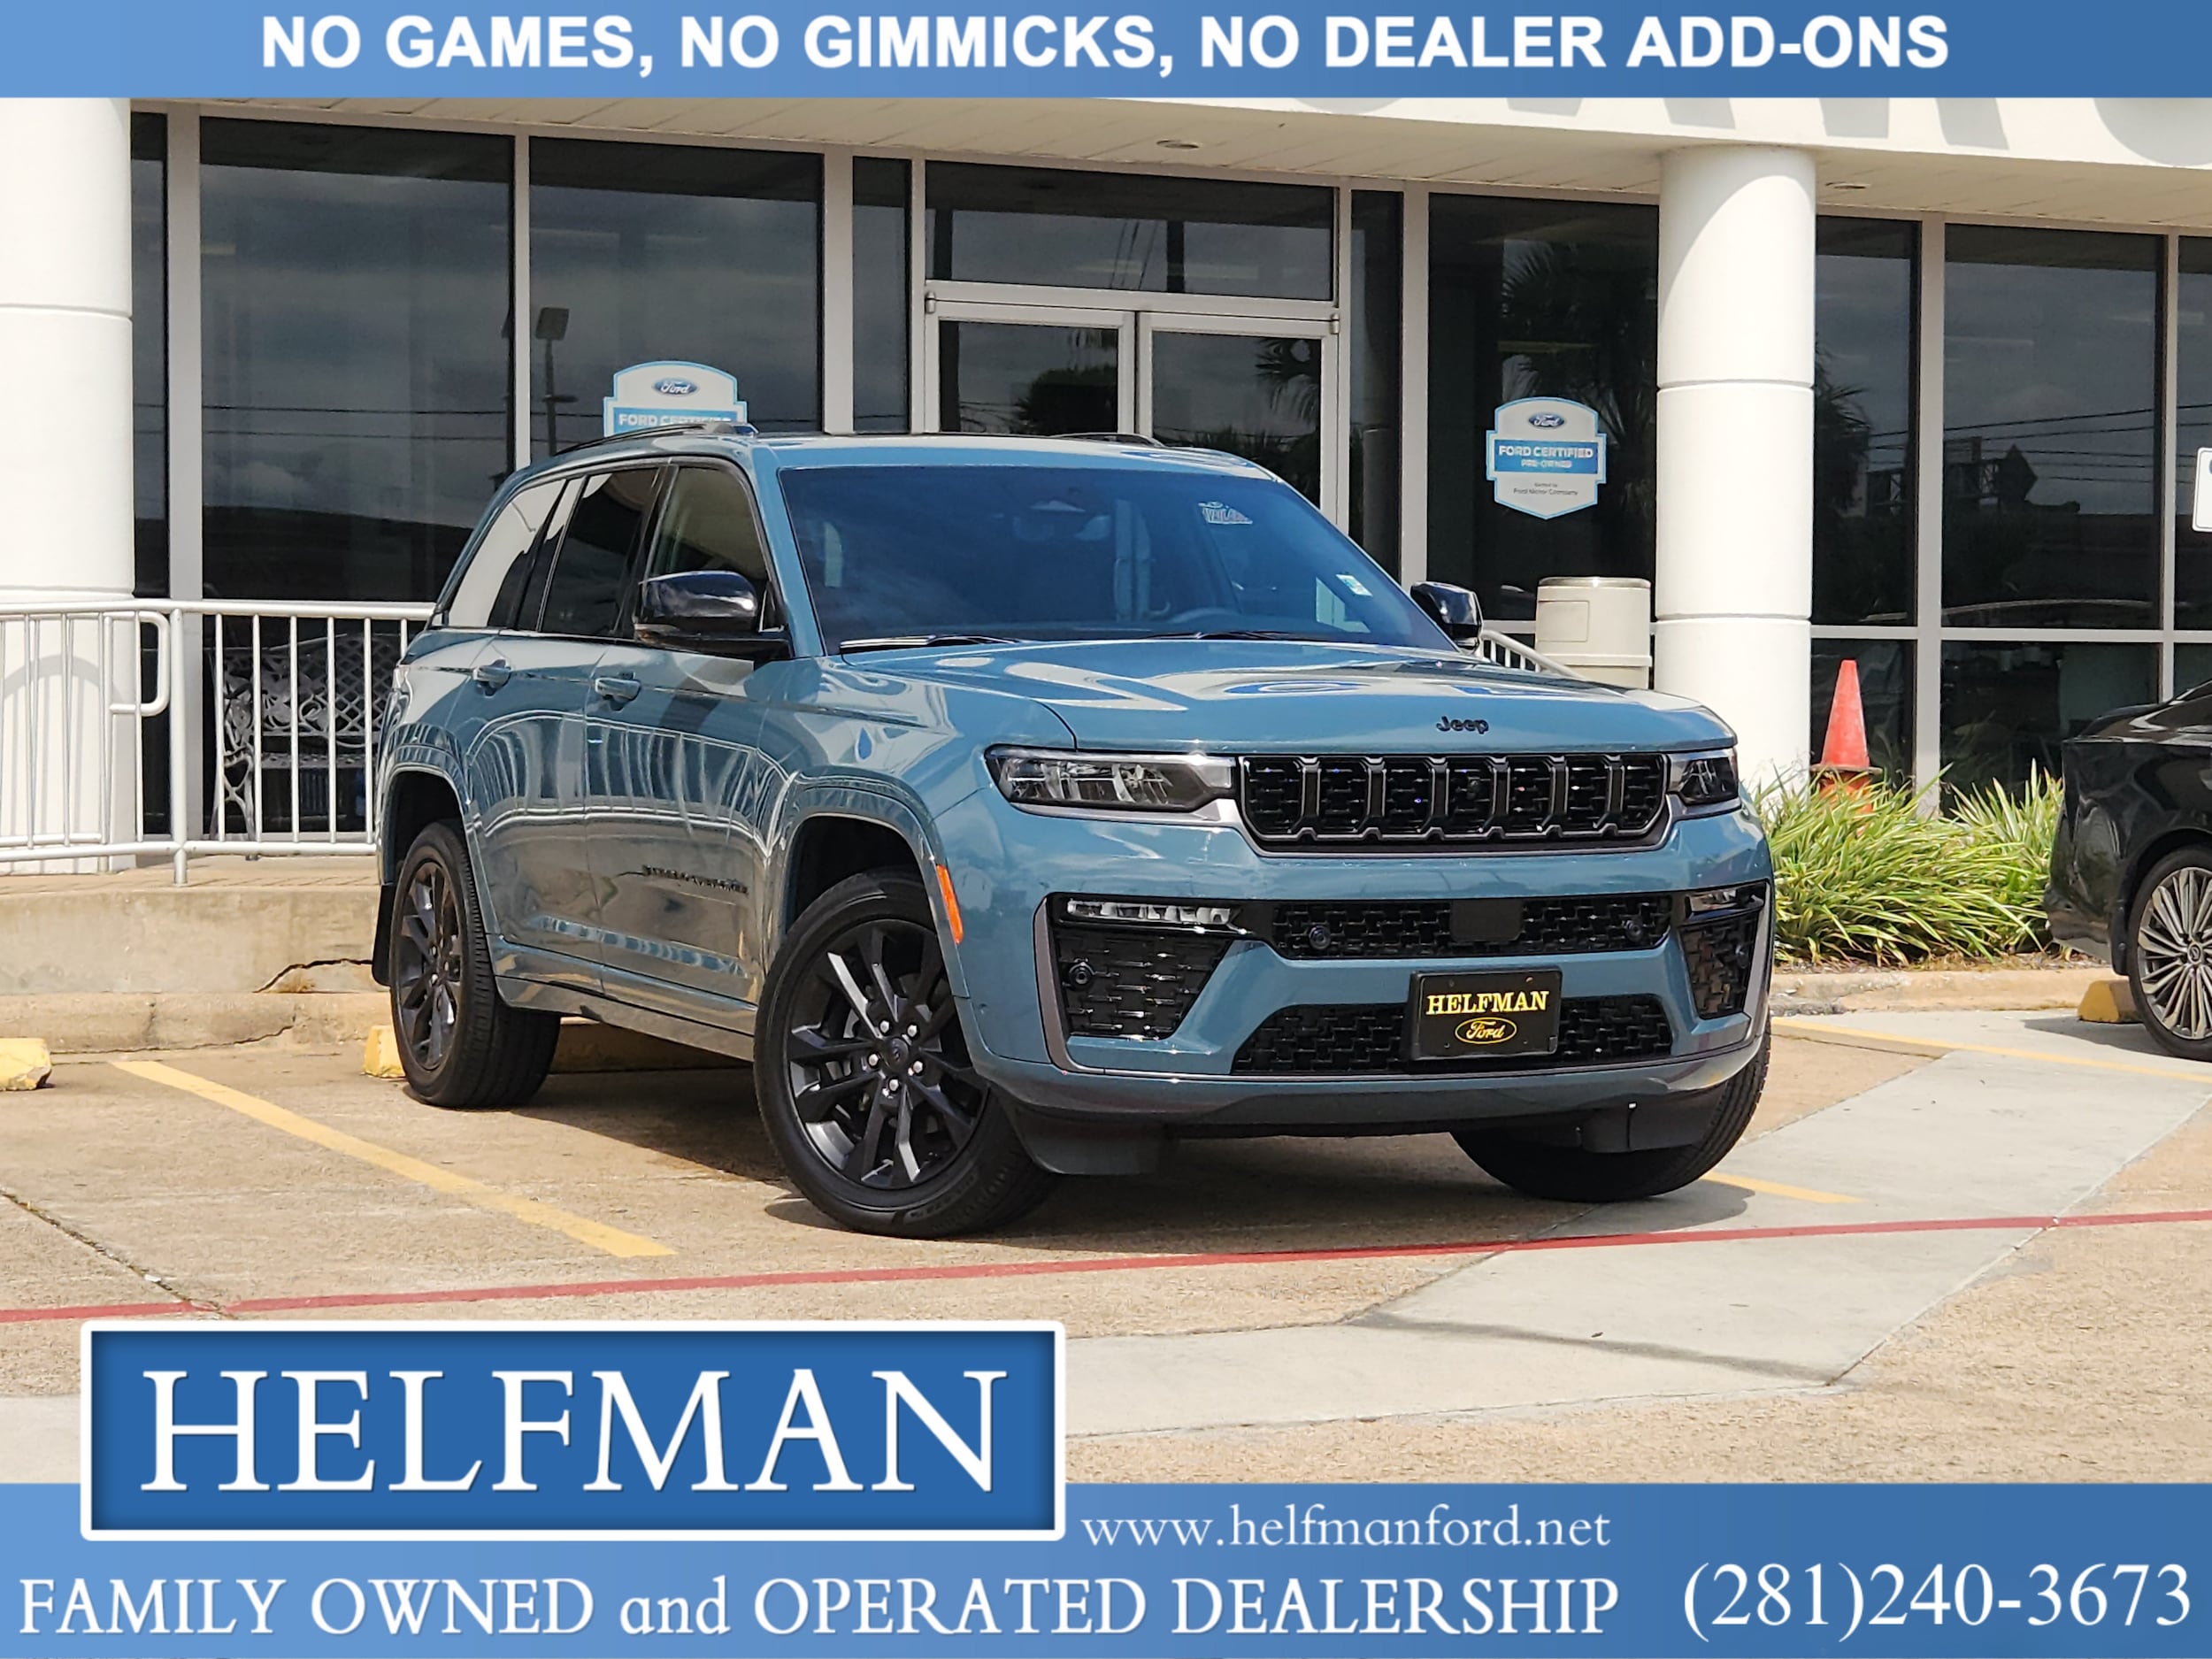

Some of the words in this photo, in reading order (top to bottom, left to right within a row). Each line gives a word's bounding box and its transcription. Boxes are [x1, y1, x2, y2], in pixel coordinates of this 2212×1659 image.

[660, 380, 691, 394] Ford
[619, 414, 657, 426] FORD
[1533, 414, 1561, 426] Ford
[1499, 445, 1532, 457] FORD
[1533, 446, 1594, 458] CERTIFIED
[1436, 715, 1489, 734] Jeep
[1425, 990, 1549, 1015] HELFMAN
[1466, 1020, 1506, 1040] Ford
